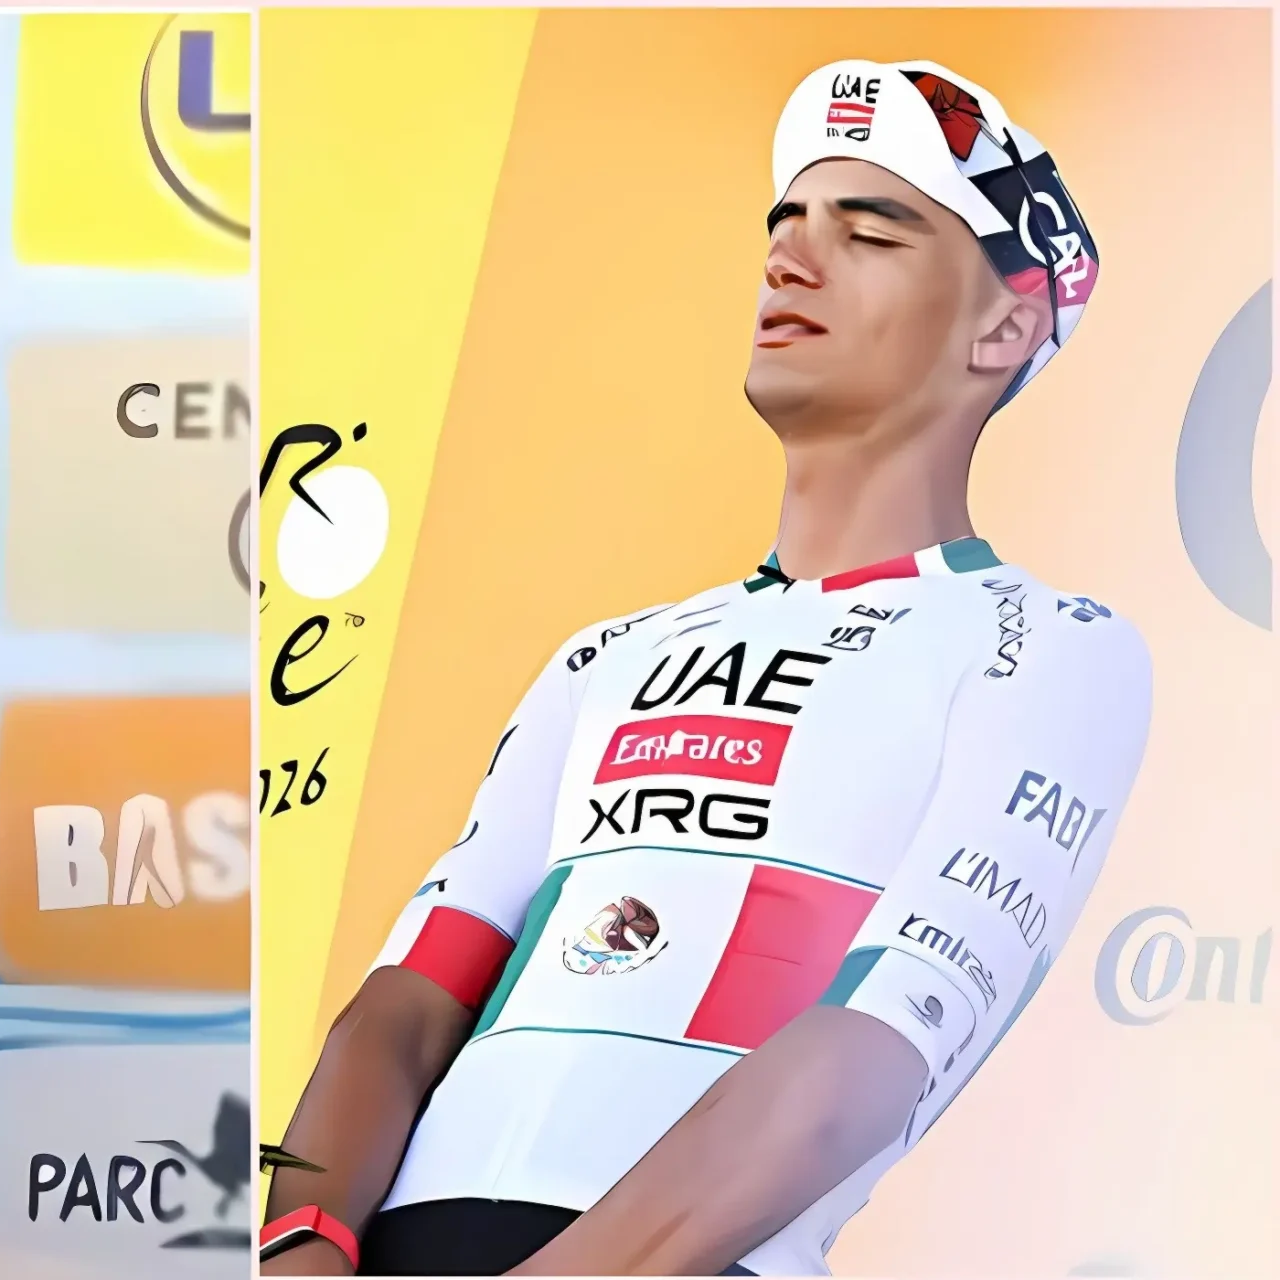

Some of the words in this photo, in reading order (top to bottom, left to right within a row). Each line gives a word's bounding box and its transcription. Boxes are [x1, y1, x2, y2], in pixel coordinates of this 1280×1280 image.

[630, 641, 833, 715] UAE
[33, 790, 251, 911] BAS
[580, 788, 771, 844] XRG
[28, 1152, 187, 1224] PARC
